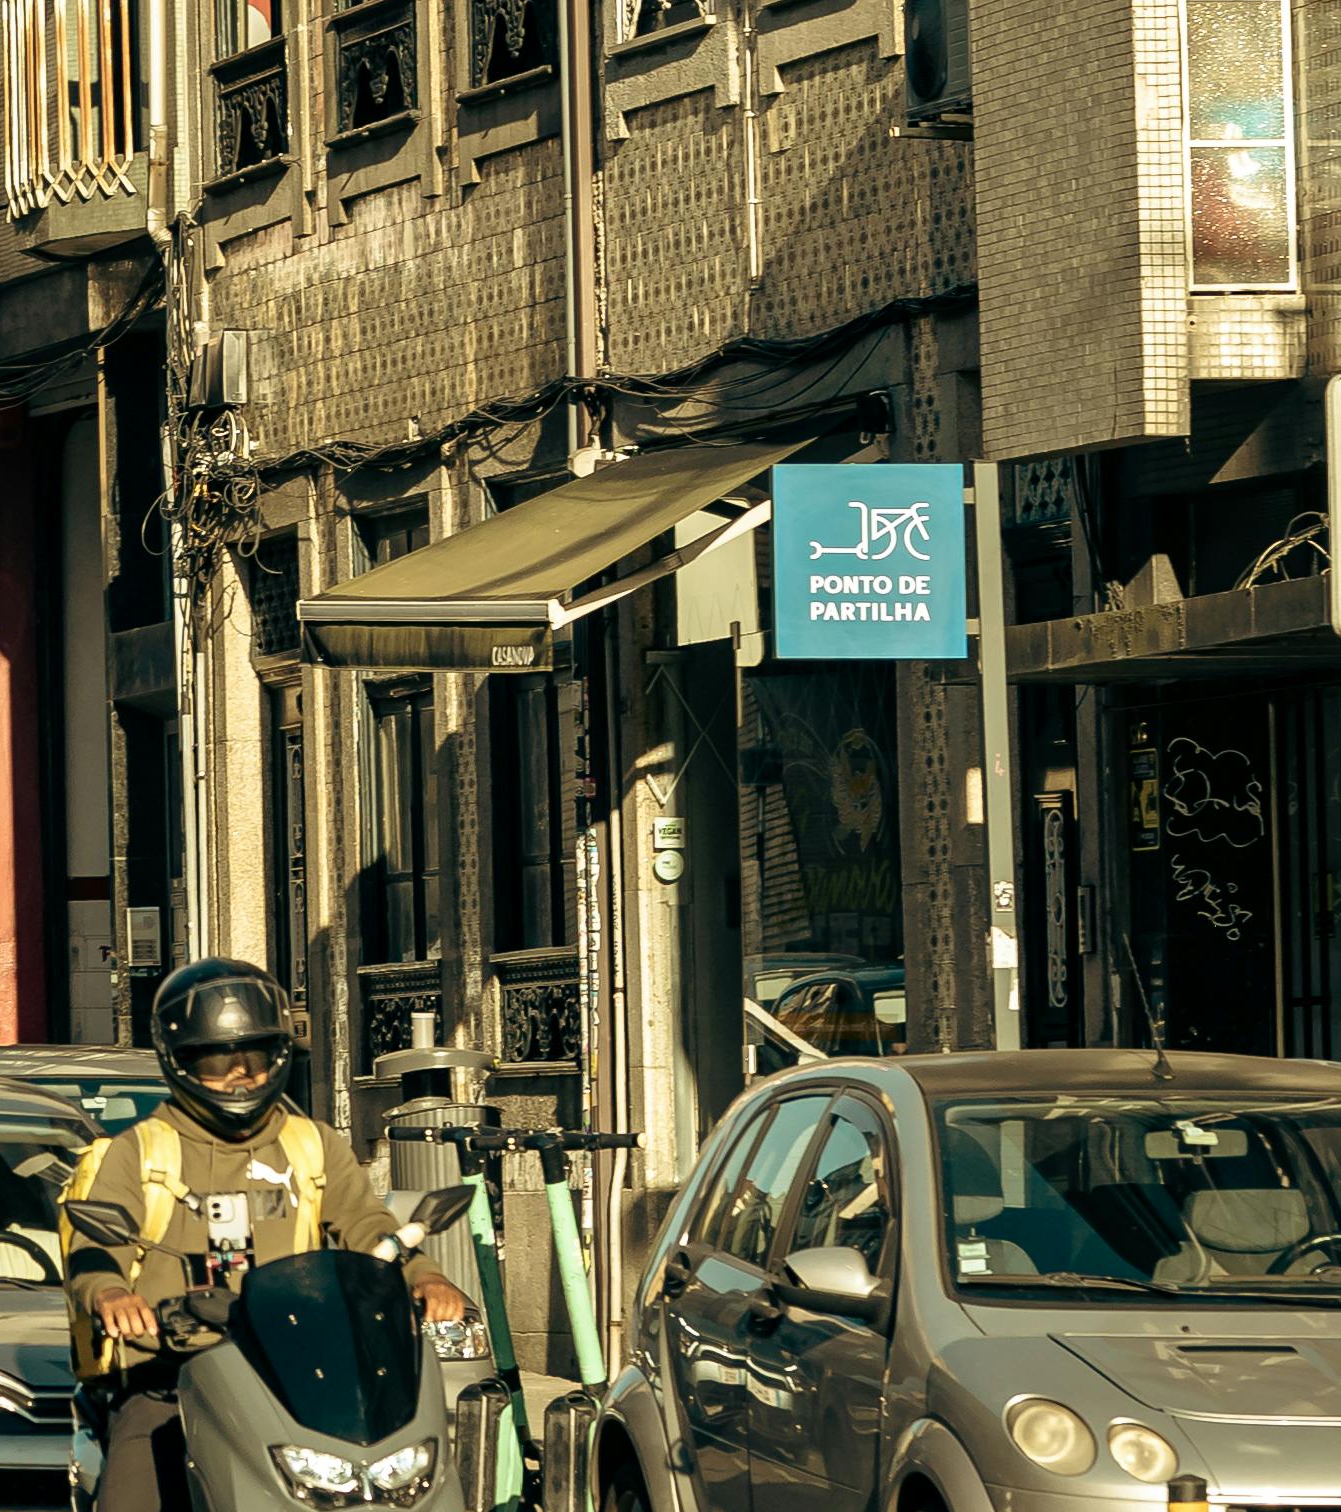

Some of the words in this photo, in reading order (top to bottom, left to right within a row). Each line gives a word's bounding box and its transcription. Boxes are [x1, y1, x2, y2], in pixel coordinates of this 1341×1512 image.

[810, 575, 893, 595] PONTO
[898, 575, 931, 595] DE
[810, 601, 931, 622] PARTILHA
